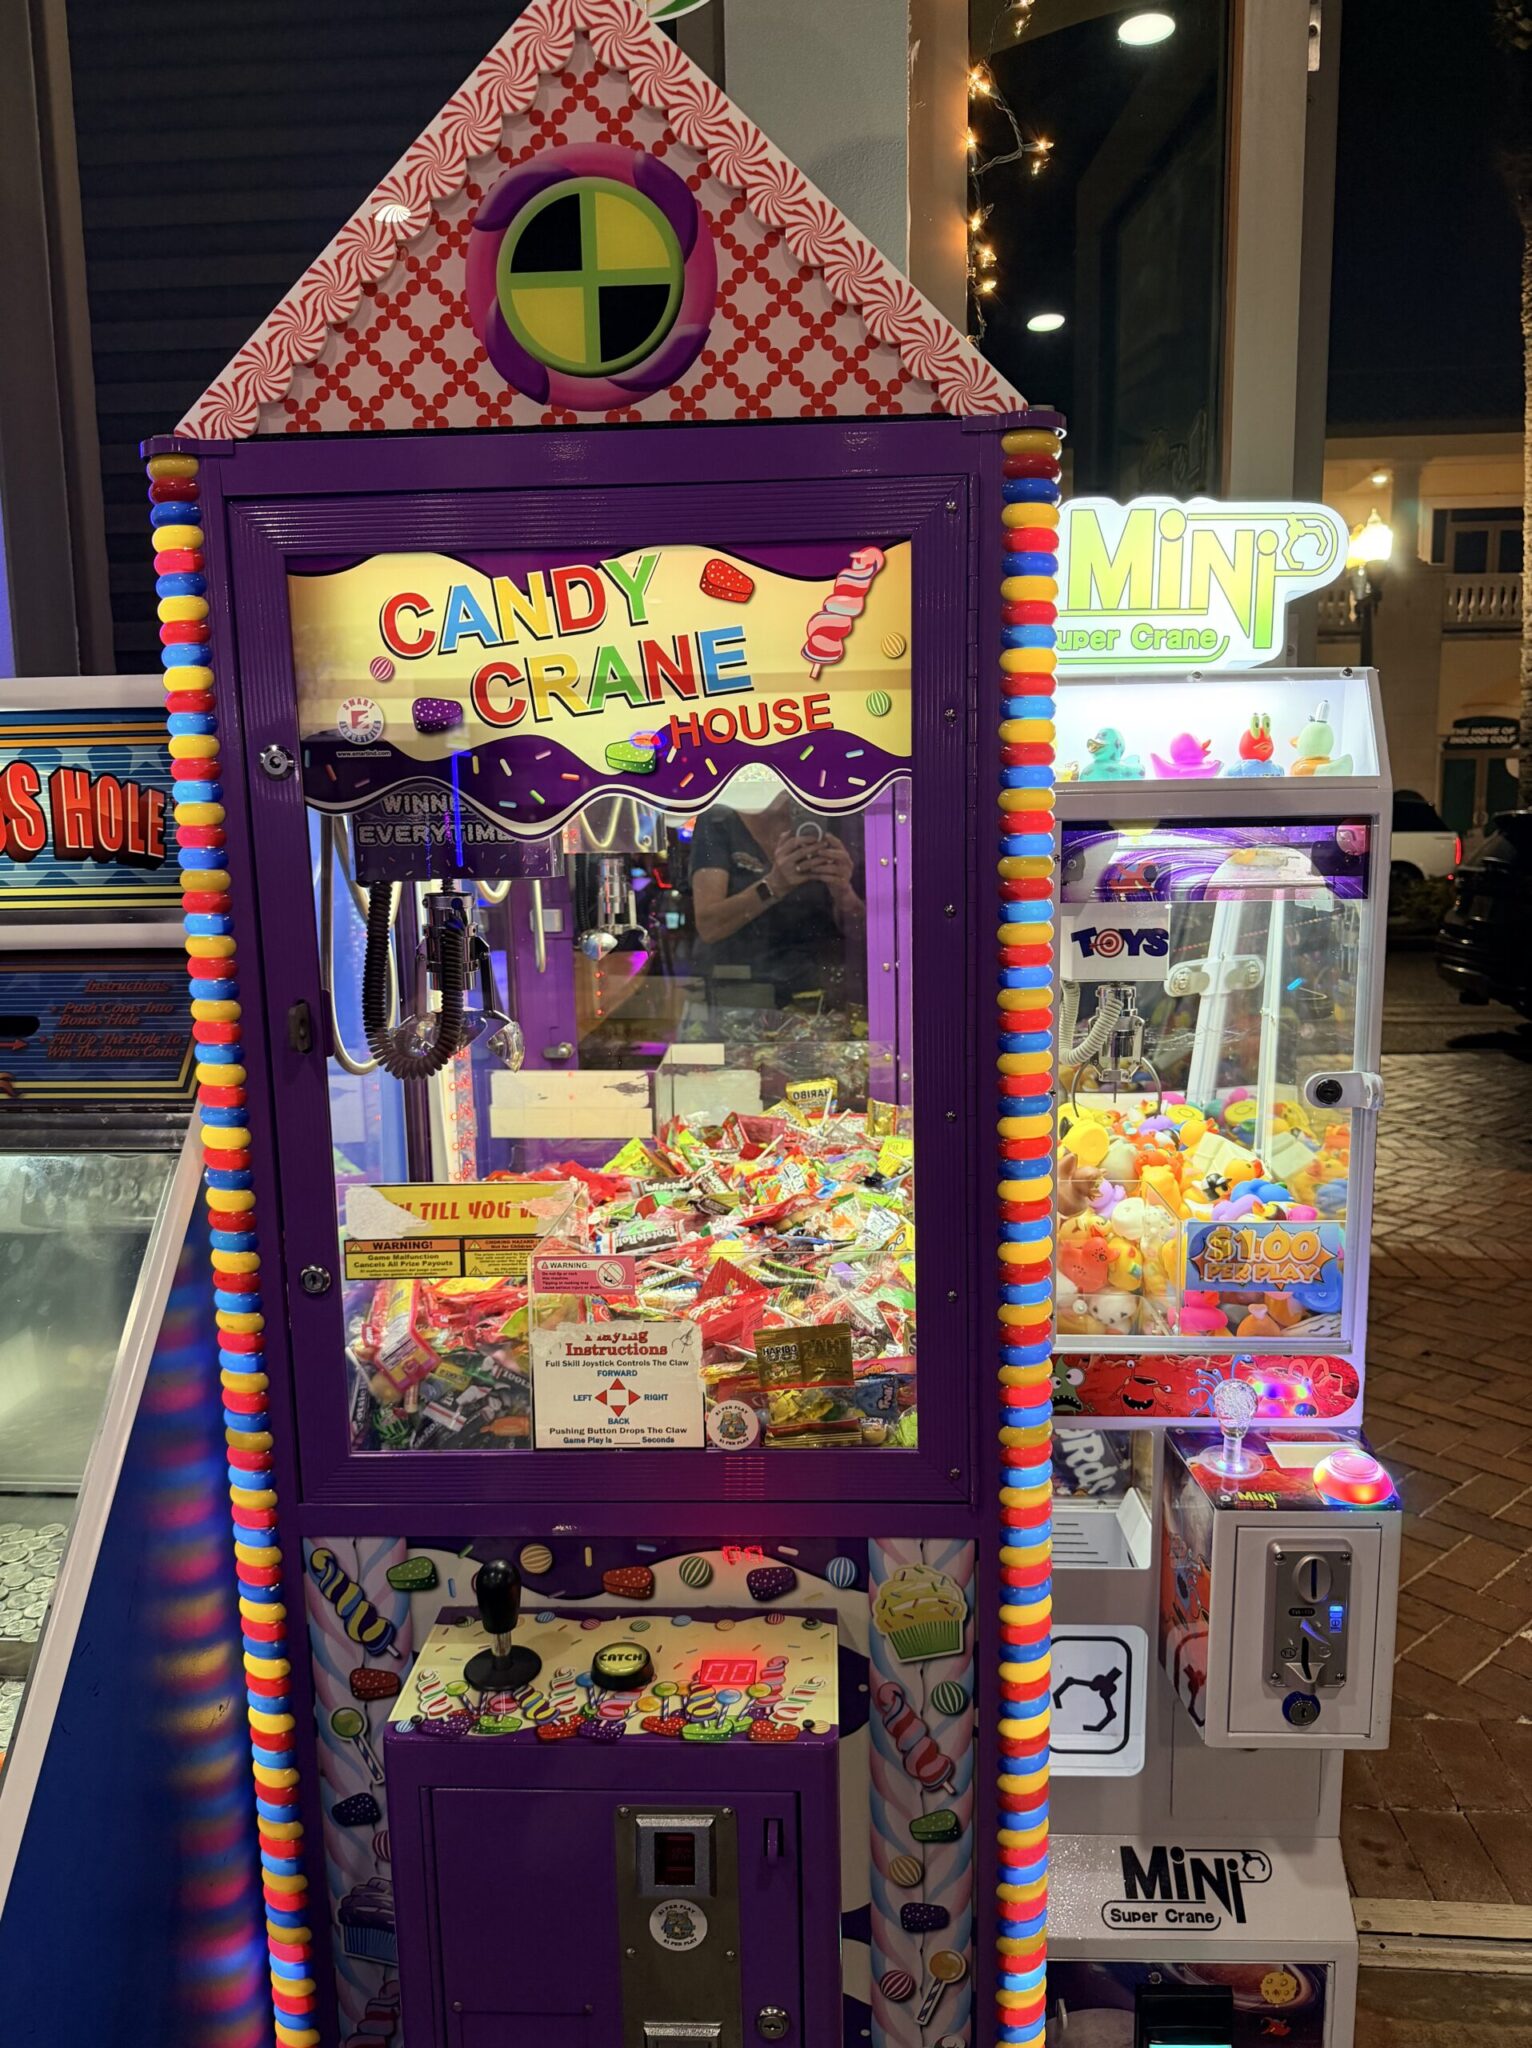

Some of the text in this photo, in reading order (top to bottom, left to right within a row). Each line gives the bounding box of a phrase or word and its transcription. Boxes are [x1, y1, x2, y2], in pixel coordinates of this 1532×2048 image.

[379, 552, 661, 660] CANDY
[1056, 623, 1218, 652] uper Crane
[470, 625, 756, 729] CRANE
[343, 698, 375, 711] SMART
[669, 693, 836, 749] HOUSE
[50, 768, 166, 868] HOLE
[1071, 927, 1169, 958] TOYS
[84, 979, 172, 992] Instructions
[63, 1002, 174, 1013] Push Coins Into
[59, 1014, 141, 1025] Bonus Hole
[51, 1033, 74, 1045] Fill
[77, 1033, 97, 1046] Up
[102, 1033, 126, 1045] The
[129, 1033, 160, 1045] Hole
[47, 1045, 179, 1057] Win The Bonus Coins
[420, 1202, 460, 1220] TILL
[468, 1200, 511, 1219] YOU
[373, 1241, 433, 1250] WARNING!
[1205, 1226, 1321, 1264] $1.00
[1205, 1263, 1320, 1283] PER PLAY
[566, 1343, 668, 1356] Instructions
[762, 1345, 797, 1356] HARIBO
[582, 1359, 615, 1368] Joystick
[616, 1359, 650, 1367] Controls
[597, 1369, 638, 1377] FORWARD
[549, 1427, 585, 1435] Pushing
[620, 1427, 645, 1435] Drops
[600, 1653, 642, 1661] CATCH
[704, 1663, 753, 1683] 00
[1110, 1908, 1215, 1924] Super Crane
